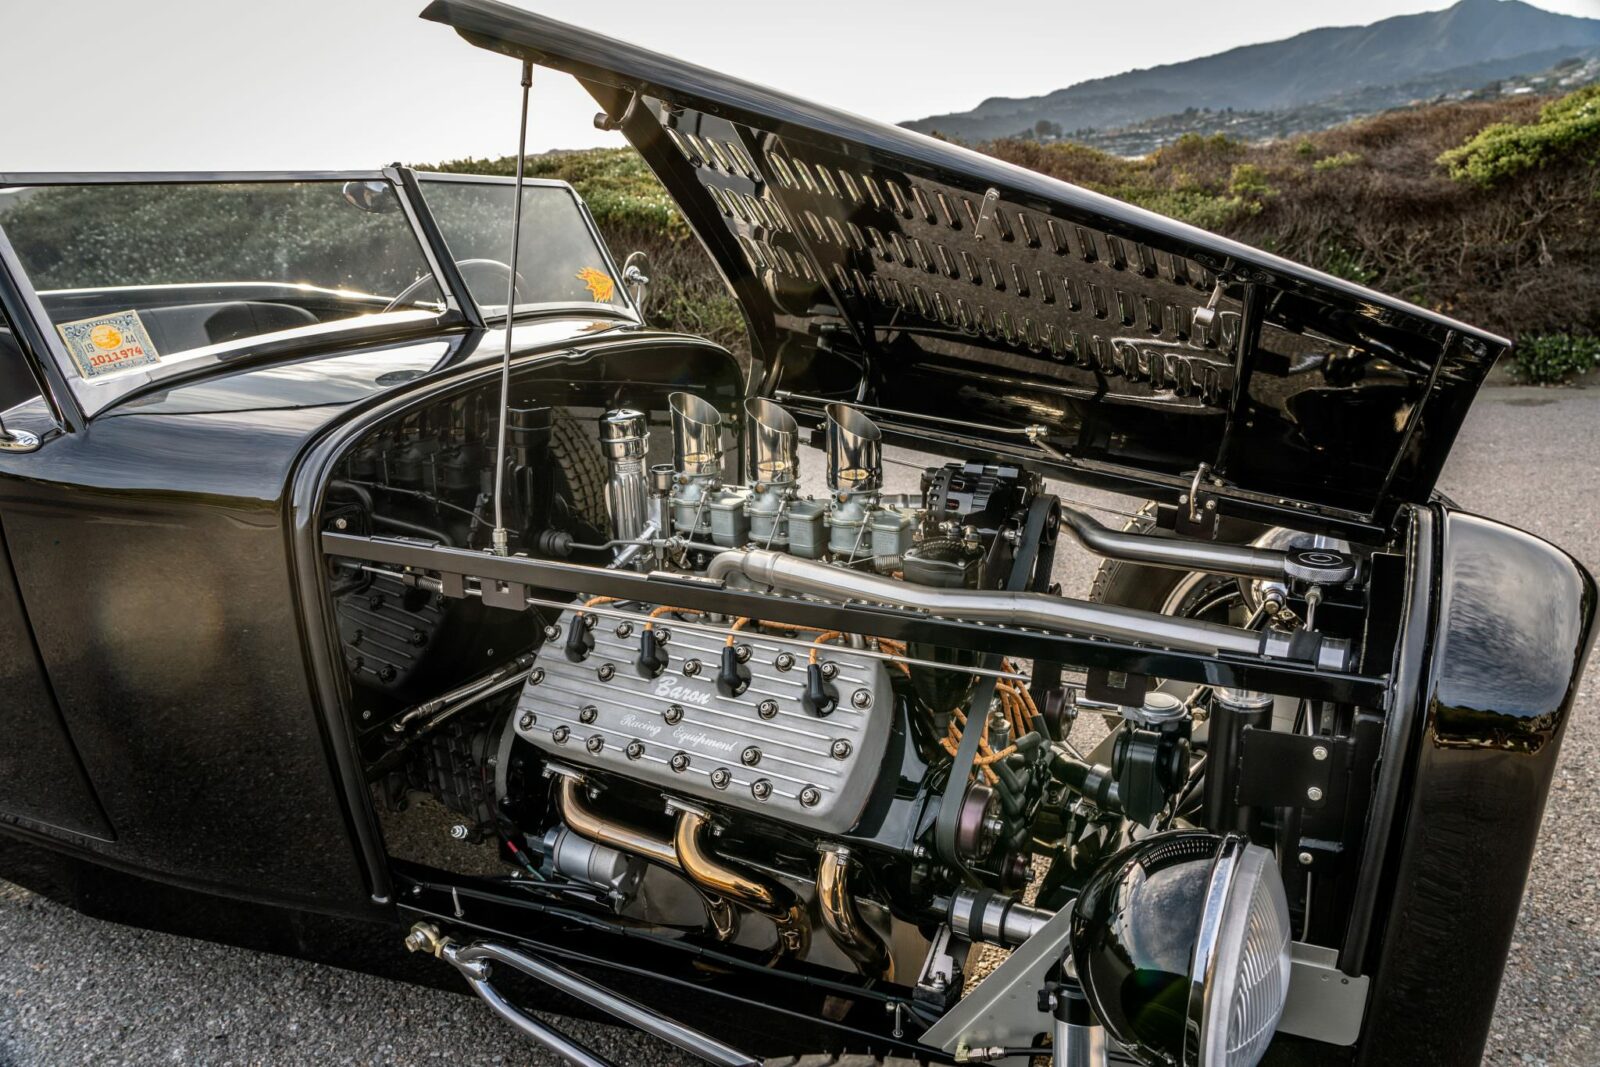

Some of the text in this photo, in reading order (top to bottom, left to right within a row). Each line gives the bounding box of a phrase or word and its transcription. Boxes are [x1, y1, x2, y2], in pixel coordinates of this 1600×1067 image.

[85, 334, 137, 353] 19 44
[89, 346, 144, 366] 1011974
[654, 676, 711, 704] Baron
[620, 714, 738, 752] Racing Equipment
